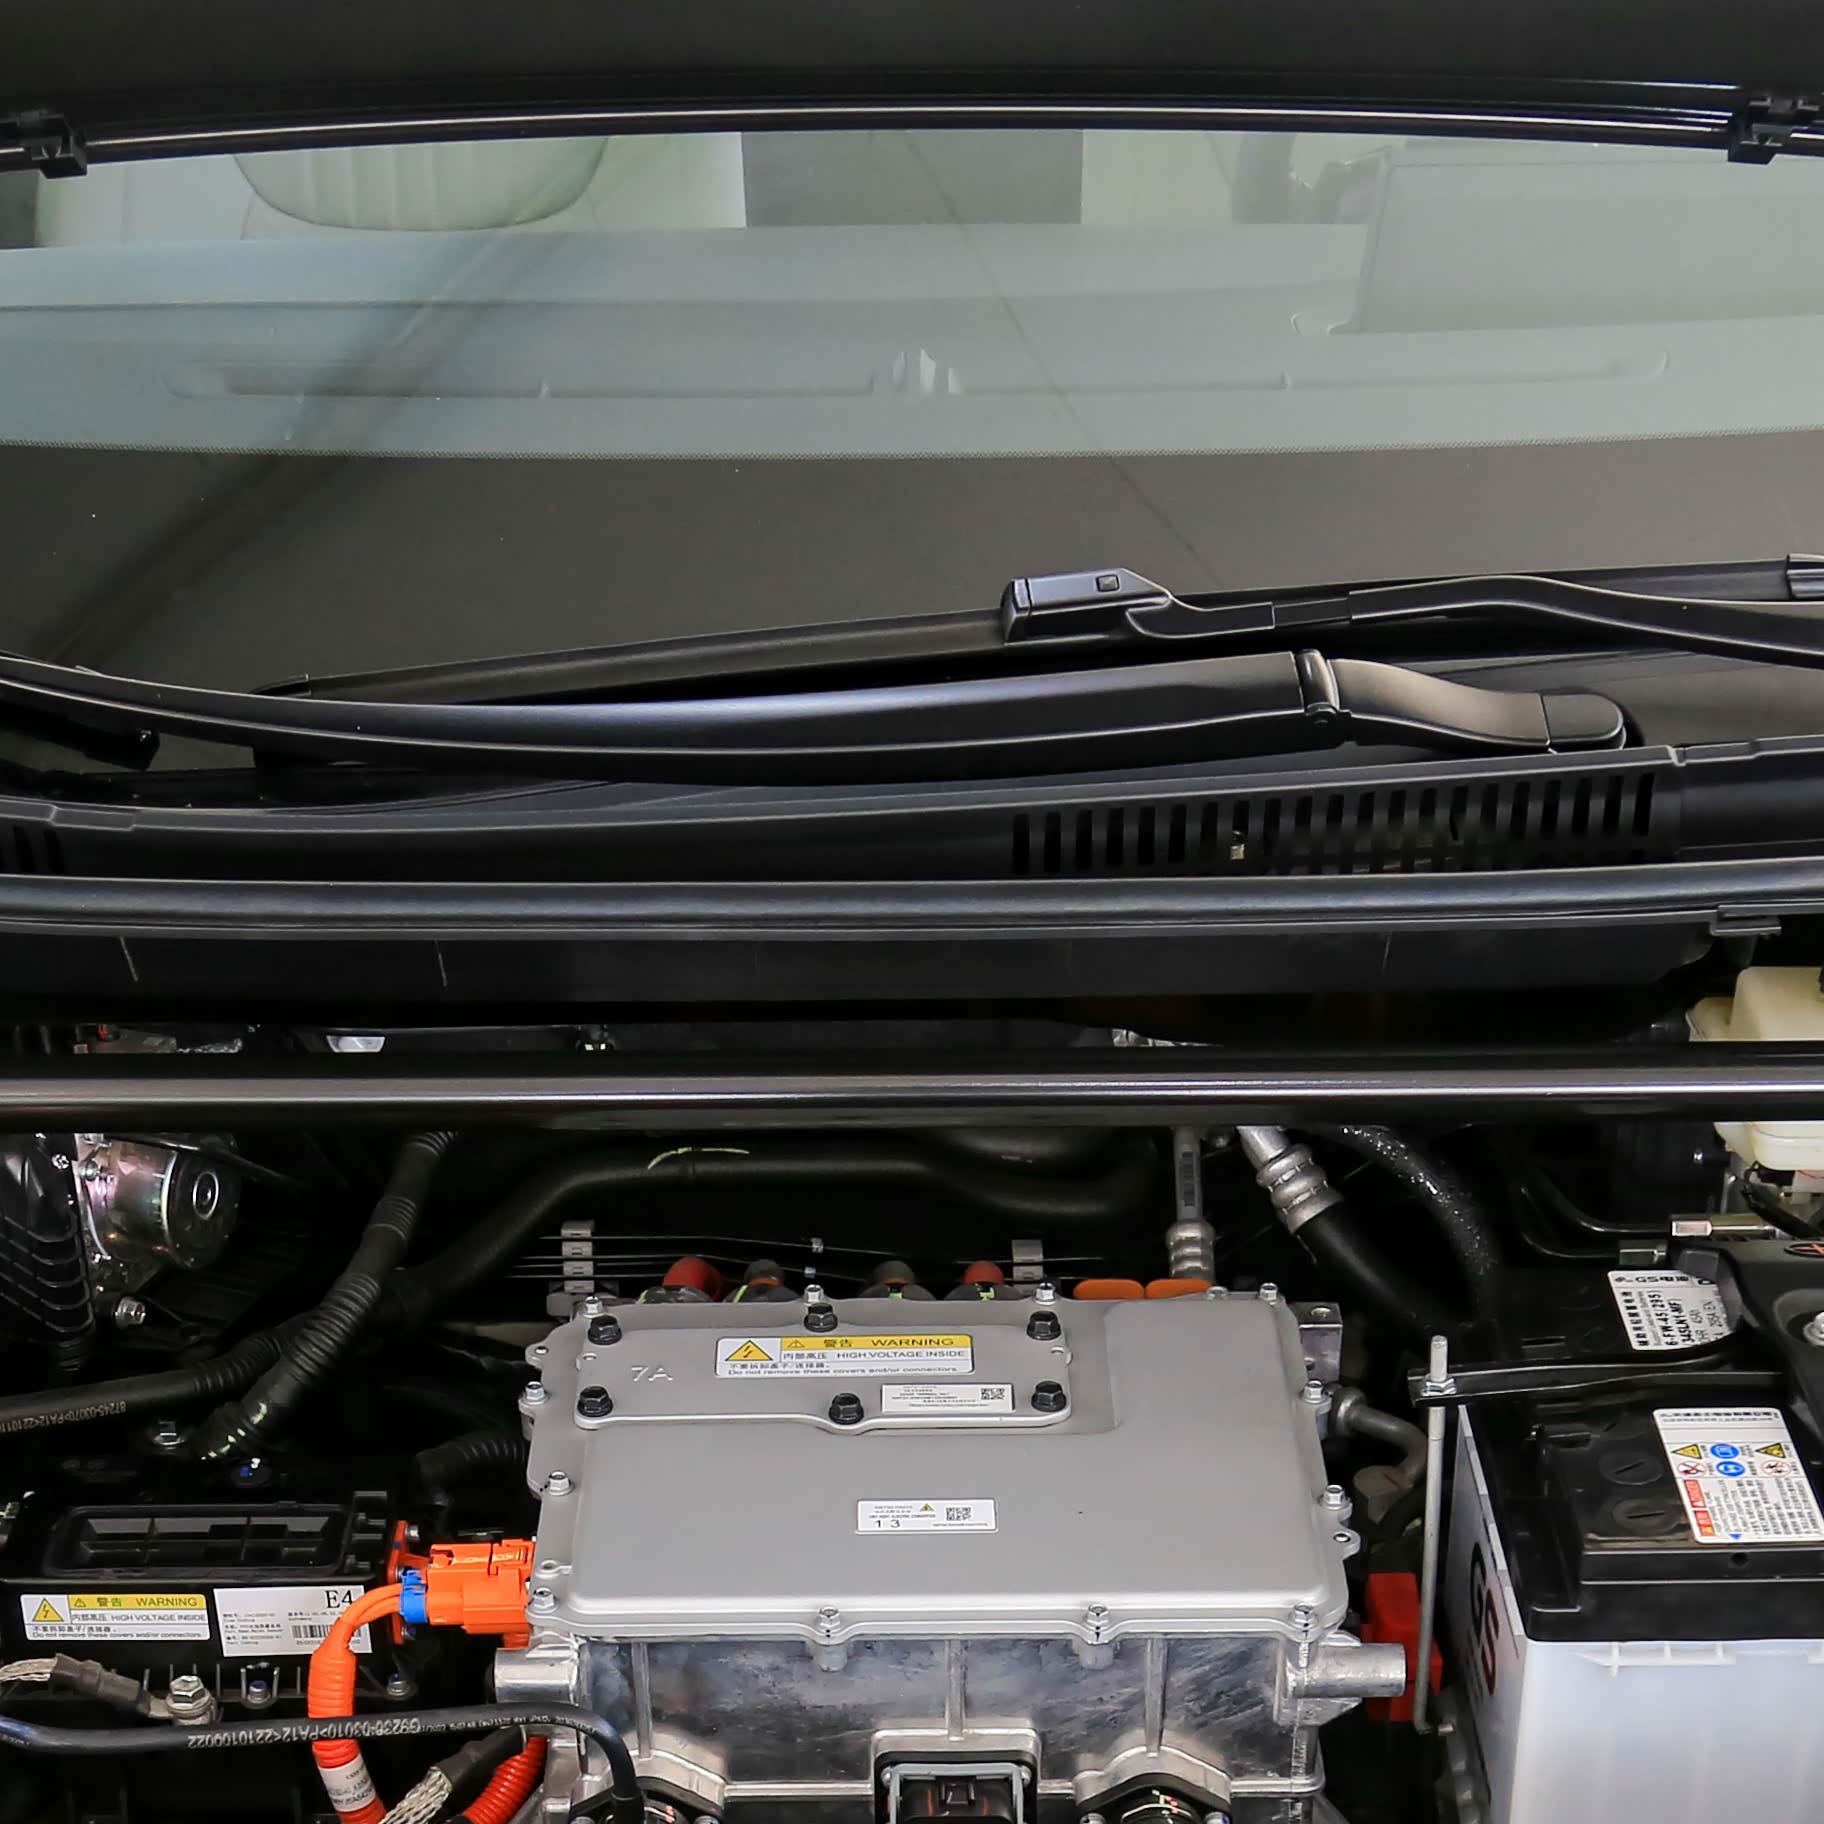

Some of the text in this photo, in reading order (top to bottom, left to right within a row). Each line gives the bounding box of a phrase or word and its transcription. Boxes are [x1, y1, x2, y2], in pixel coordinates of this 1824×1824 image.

[871, 1338, 955, 1347] WARNING
[870, 1350, 923, 1358] VOLTAGE
[925, 1350, 965, 1358] INSIDE
[631, 1364, 674, 1382] 7A
[135, 1597, 197, 1607] WARNING
[325, 1590, 353, 1609] E4
